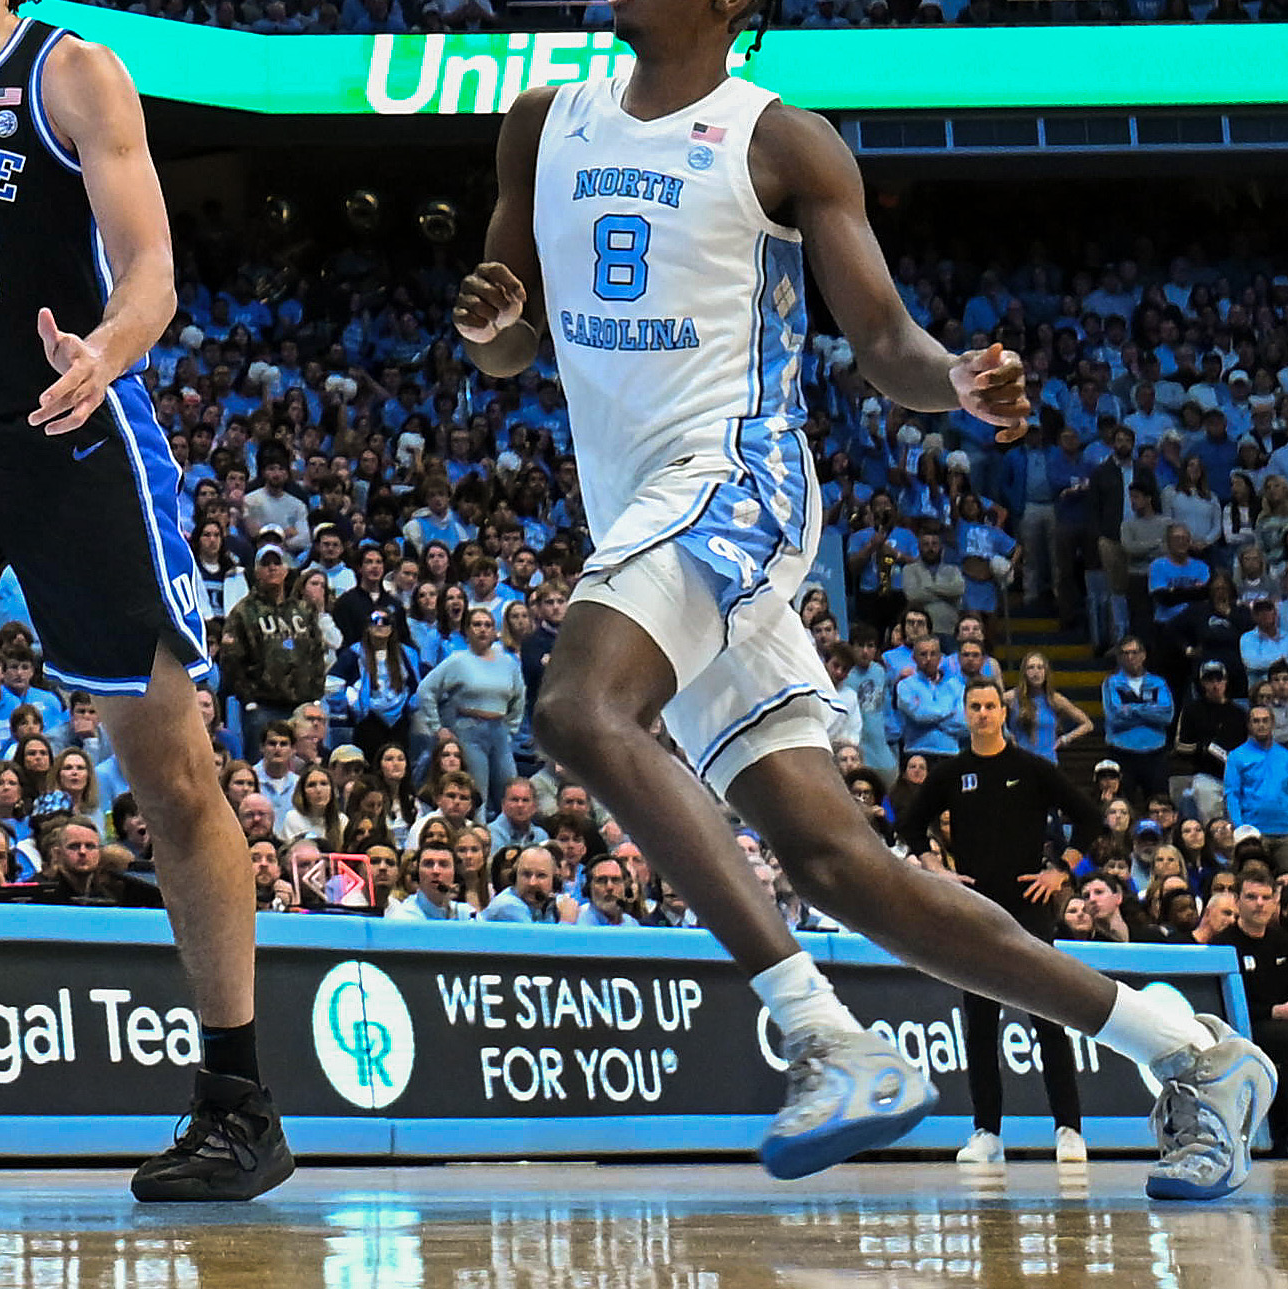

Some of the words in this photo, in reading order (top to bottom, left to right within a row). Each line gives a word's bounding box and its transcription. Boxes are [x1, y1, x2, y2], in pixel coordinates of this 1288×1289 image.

[367, 33, 746, 114] UniFi
[573, 167, 684, 209] NORTH
[592, 214, 652, 302] 8
[560, 310, 700, 351] CAROLINA
[89, 988, 202, 1066] Tea
[437, 974, 507, 1029] WE
[513, 975, 643, 1031] STAND
[653, 978, 703, 1032] UP
[480, 1045, 567, 1101] FOR
[875, 1007, 967, 1081] egal
